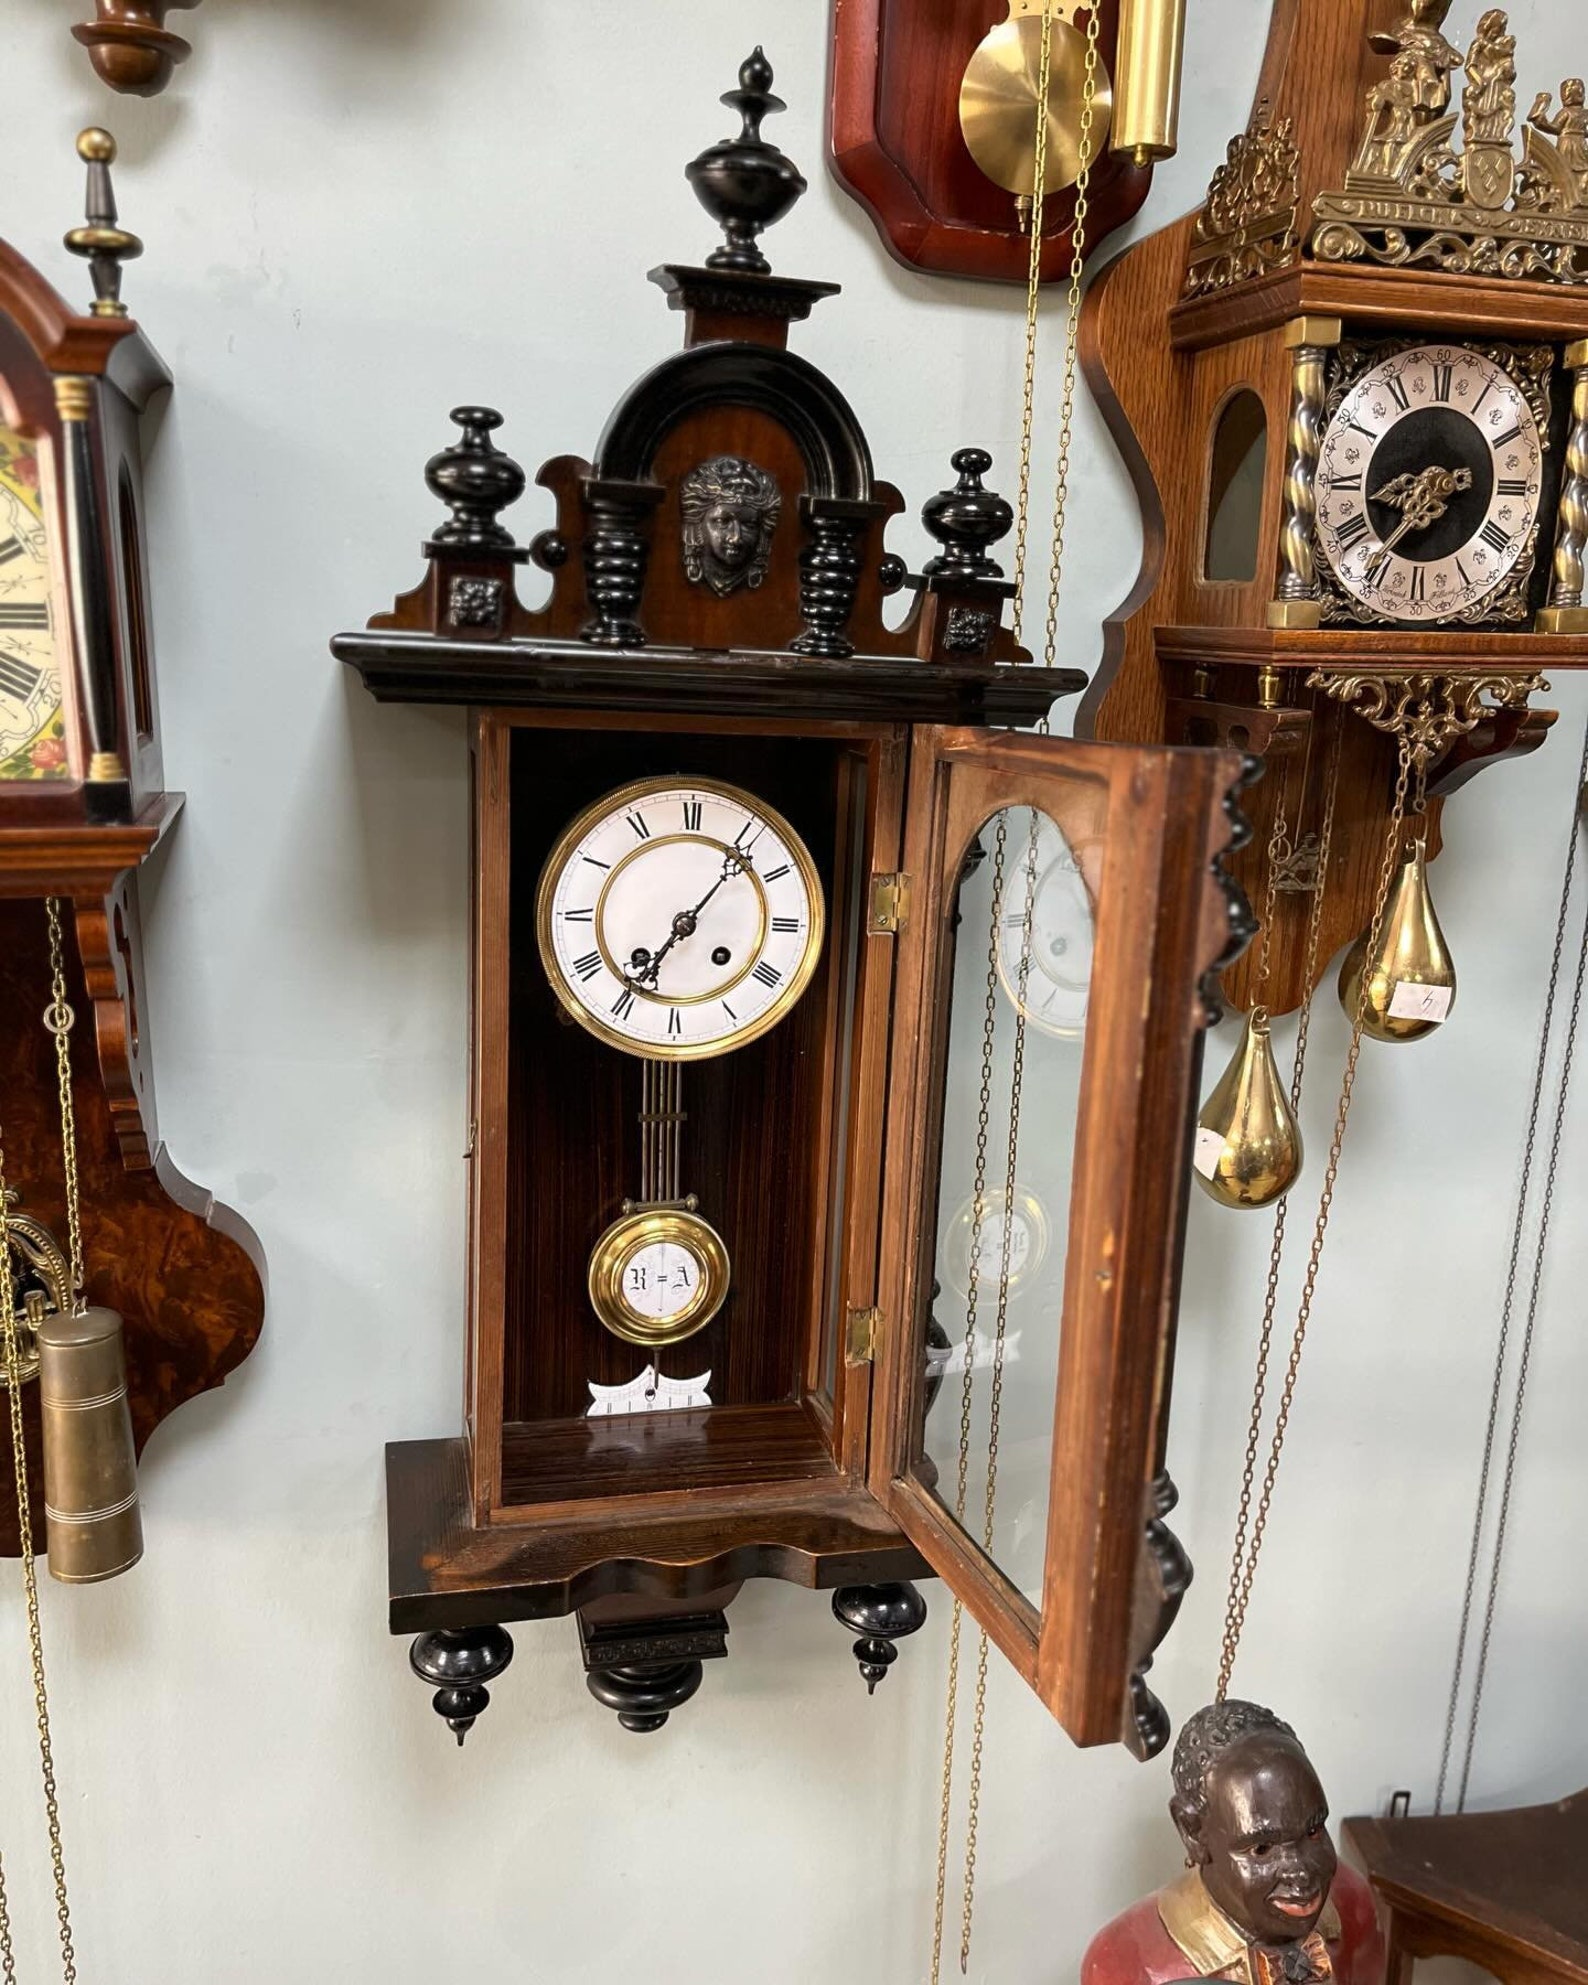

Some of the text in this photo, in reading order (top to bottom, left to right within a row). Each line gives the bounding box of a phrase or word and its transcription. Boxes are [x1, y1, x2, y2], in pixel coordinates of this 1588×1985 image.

[1436, 349, 1451, 361] 60
[1409, 605, 1423, 616] 30
[680, 802, 703, 831] XII
[763, 864, 791, 883] II
[771, 917, 799, 933] III
[751, 960, 783, 989] IIII
[667, 1007, 682, 1034] VI
